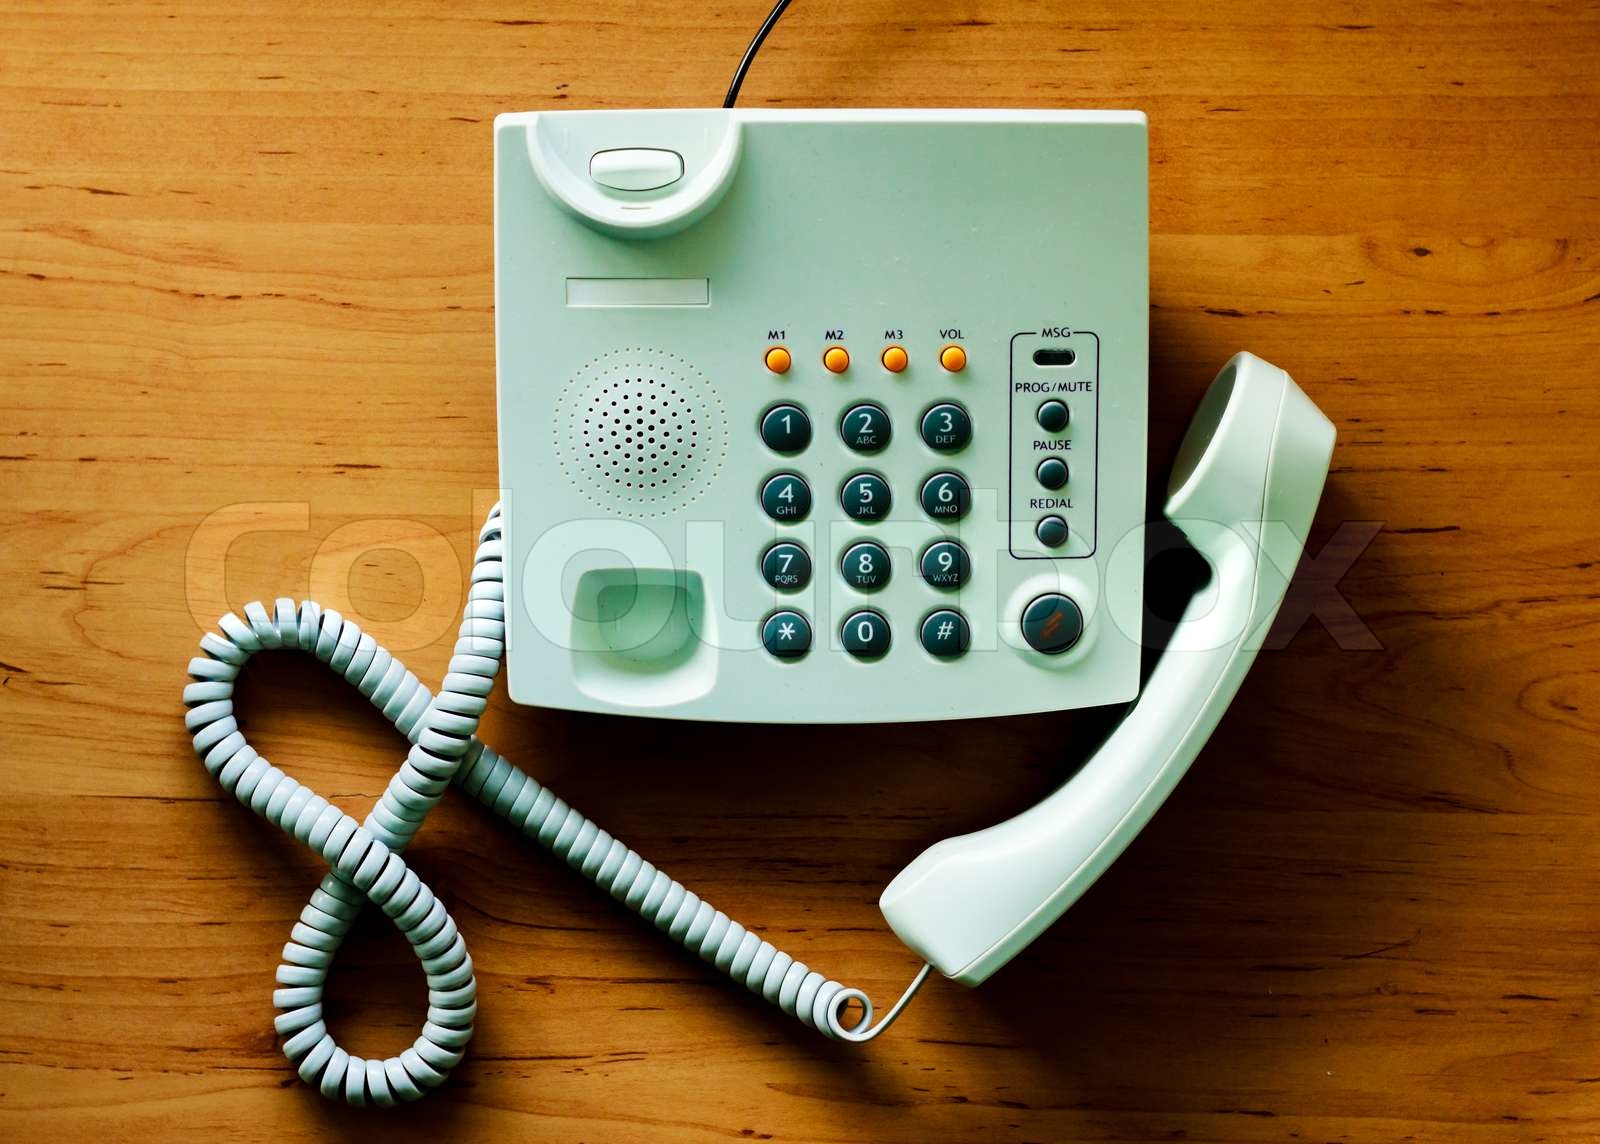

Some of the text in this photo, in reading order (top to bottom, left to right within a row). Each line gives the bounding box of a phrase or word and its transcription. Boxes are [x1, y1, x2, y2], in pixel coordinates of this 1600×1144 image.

[767, 329, 786, 340] M1
[825, 329, 844, 341] M2
[884, 329, 904, 340] M3
[939, 329, 965, 340] VOL
[1041, 327, 1071, 339] MSG
[1015, 381, 1093, 393] PROG/MUTE
[780, 414, 791, 434] 1
[858, 413, 873, 434] 2
[939, 412, 953, 432] 3
[855, 435, 877, 445] ABC
[935, 434, 956, 444] DEF
[1033, 440, 1072, 451] PAUSE
[778, 483, 794, 503] 4
[858, 483, 873, 503] 5
[937, 481, 953, 502] 6
[934, 504, 958, 514] MNO
[1029, 498, 1074, 509] REDIAL
[776, 505, 797, 515] GHI
[856, 505, 877, 515] JKL
[778, 554, 794, 574] 7
[858, 553, 873, 574] 8
[937, 551, 953, 572] 9
[774, 574, 799, 585] PQRS
[855, 574, 877, 584] TUV
[932, 573, 959, 583] WXYZ
[857, 621, 873, 642] 0
[936, 620, 954, 640] #
